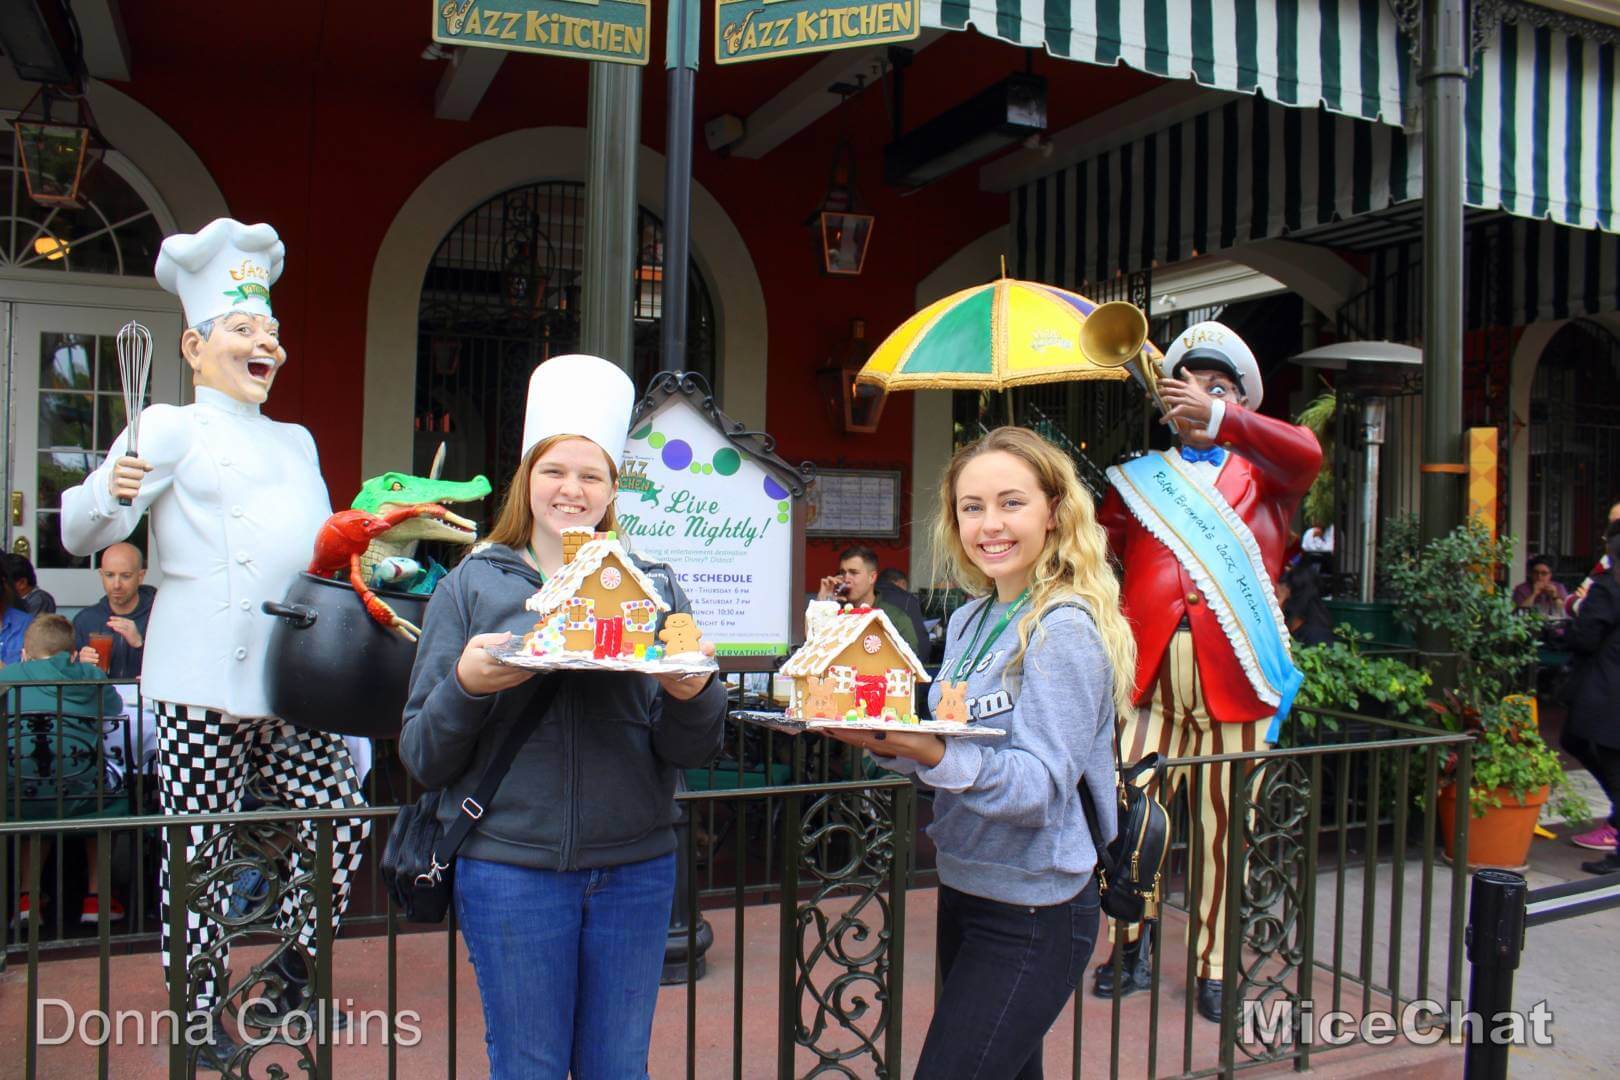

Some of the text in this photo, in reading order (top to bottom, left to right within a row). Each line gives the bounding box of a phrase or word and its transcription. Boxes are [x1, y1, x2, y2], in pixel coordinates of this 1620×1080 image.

[619, 459, 648, 478] AZZ
[664, 490, 720, 514] Live
[618, 514, 772, 547] Music Nightly!
[693, 573, 753, 583] SCHEDULE
